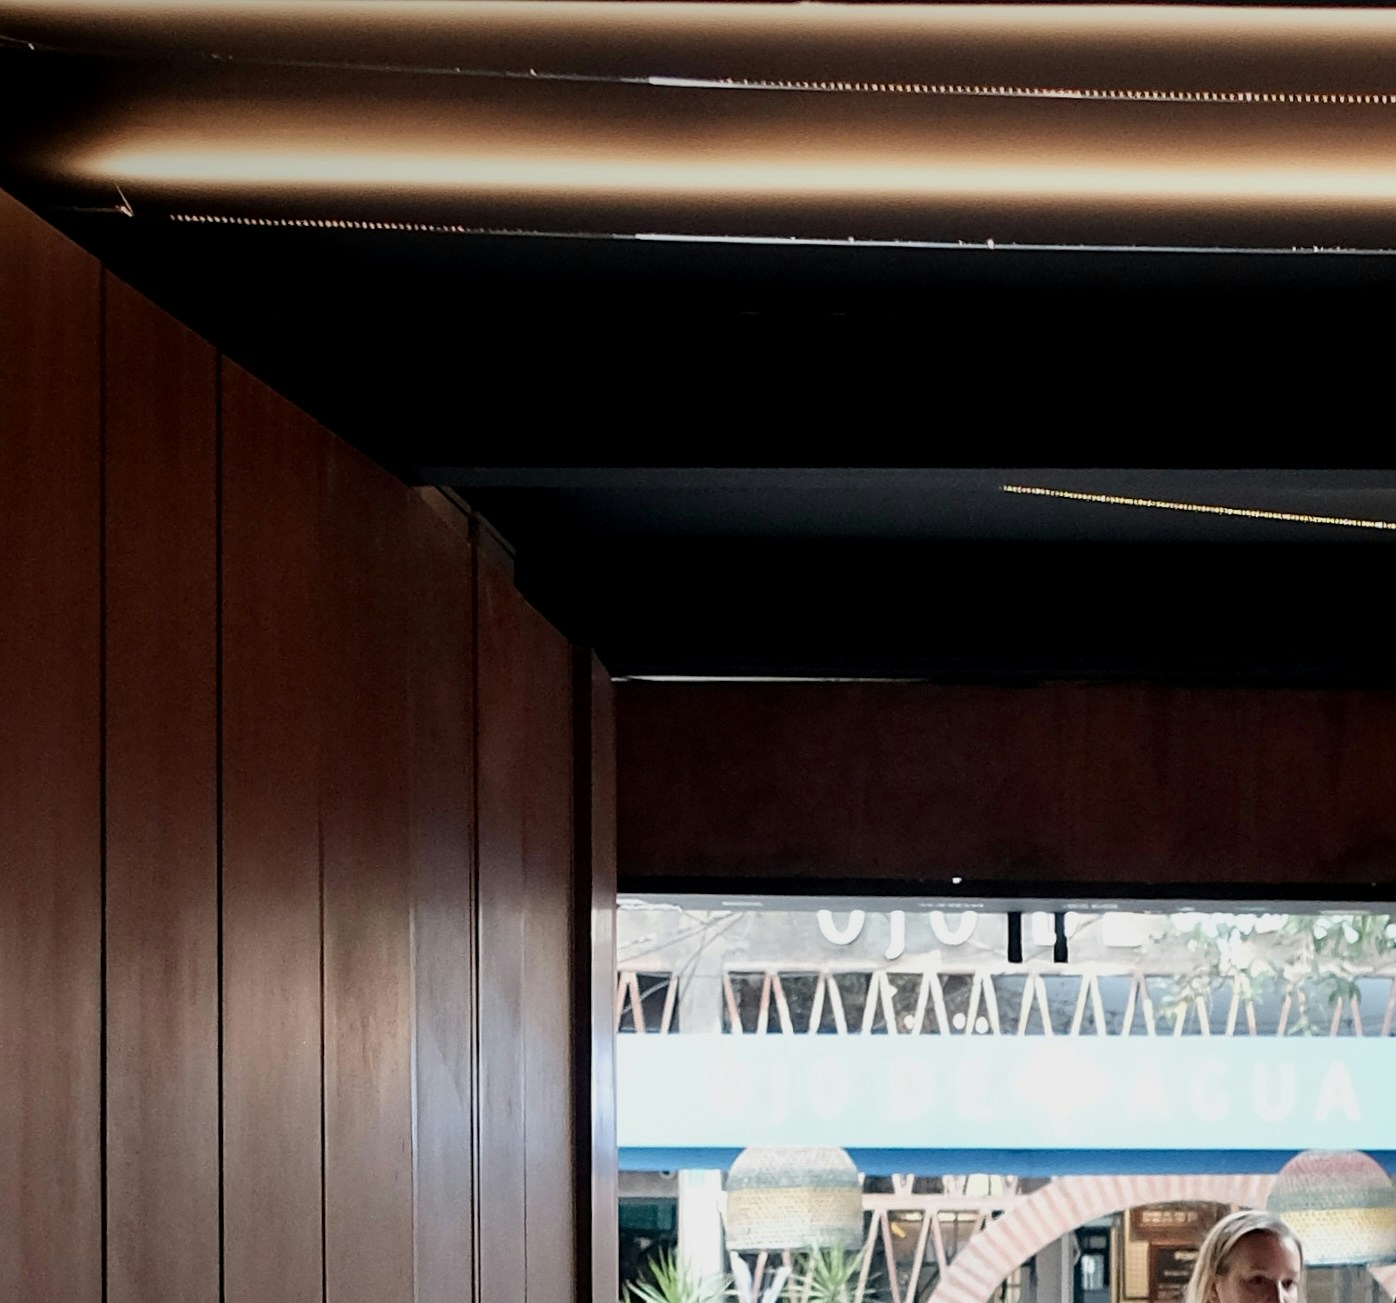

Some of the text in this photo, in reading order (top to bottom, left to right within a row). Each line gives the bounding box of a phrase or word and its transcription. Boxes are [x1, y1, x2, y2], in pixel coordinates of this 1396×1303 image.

[704, 1056, 1361, 1124] OJO DE AGUA
